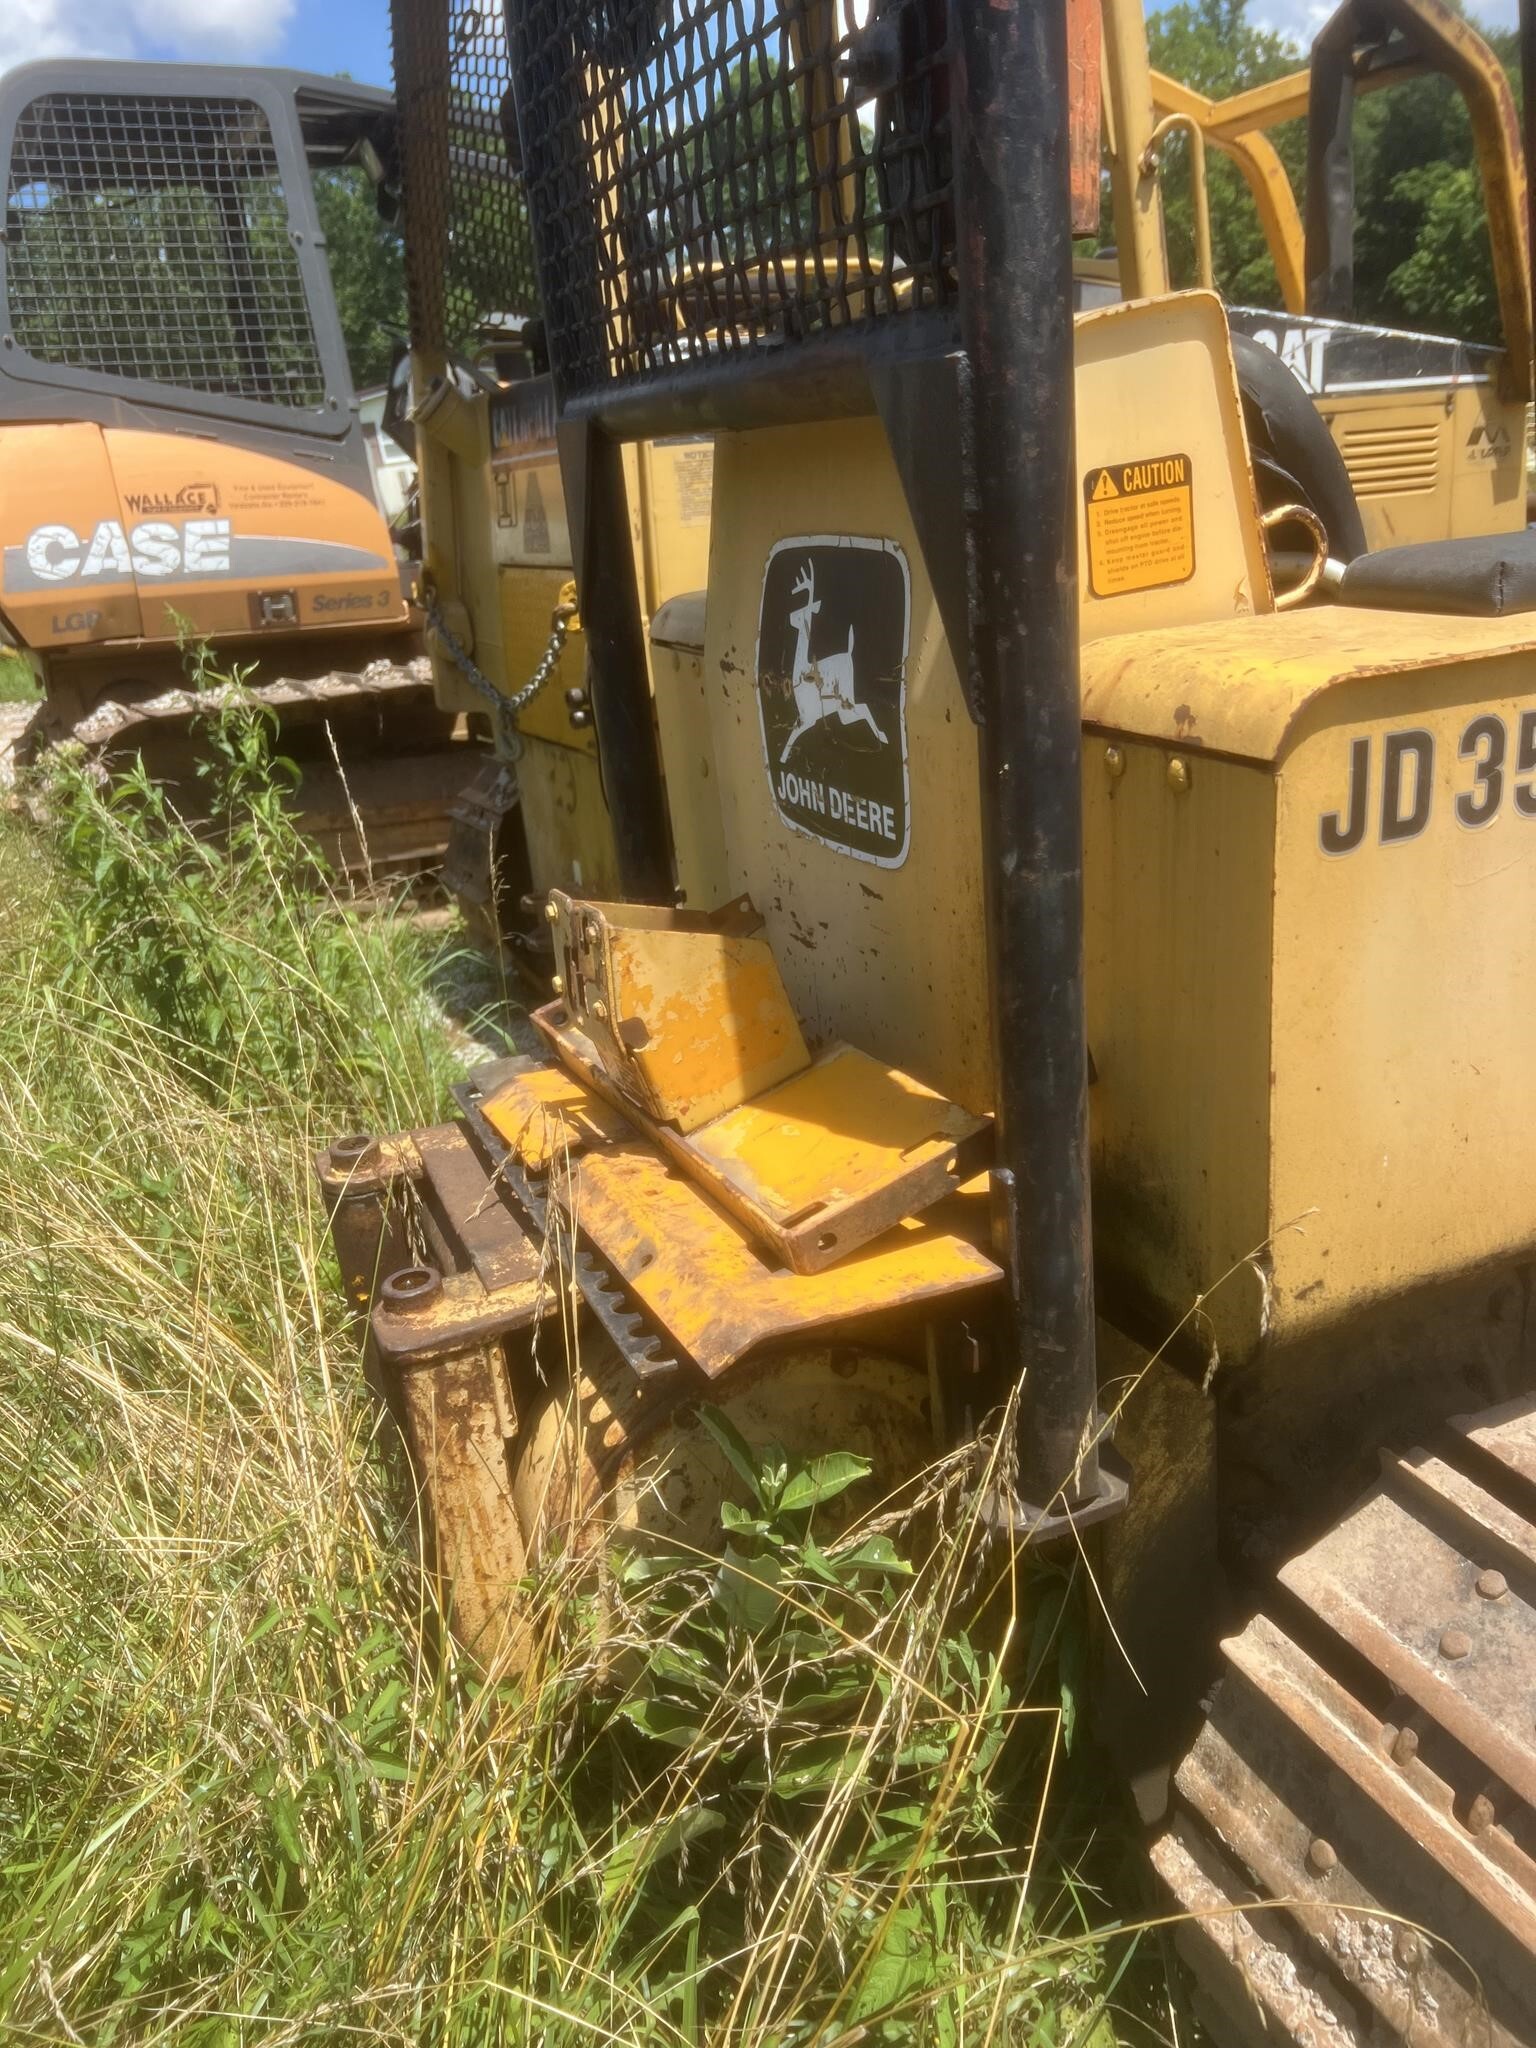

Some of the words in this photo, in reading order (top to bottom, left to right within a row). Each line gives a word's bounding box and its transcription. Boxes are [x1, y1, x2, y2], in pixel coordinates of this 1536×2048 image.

[1123, 459, 1185, 492] CAUTION
[124, 492, 206, 513] WALLACE
[27, 519, 231, 581] CASE
[312, 591, 371, 614] Series
[375, 589, 391, 608] 3
[778, 771, 826, 815] JOHN
[829, 787, 897, 841] DEERE
[1319, 727, 1437, 857] JD
